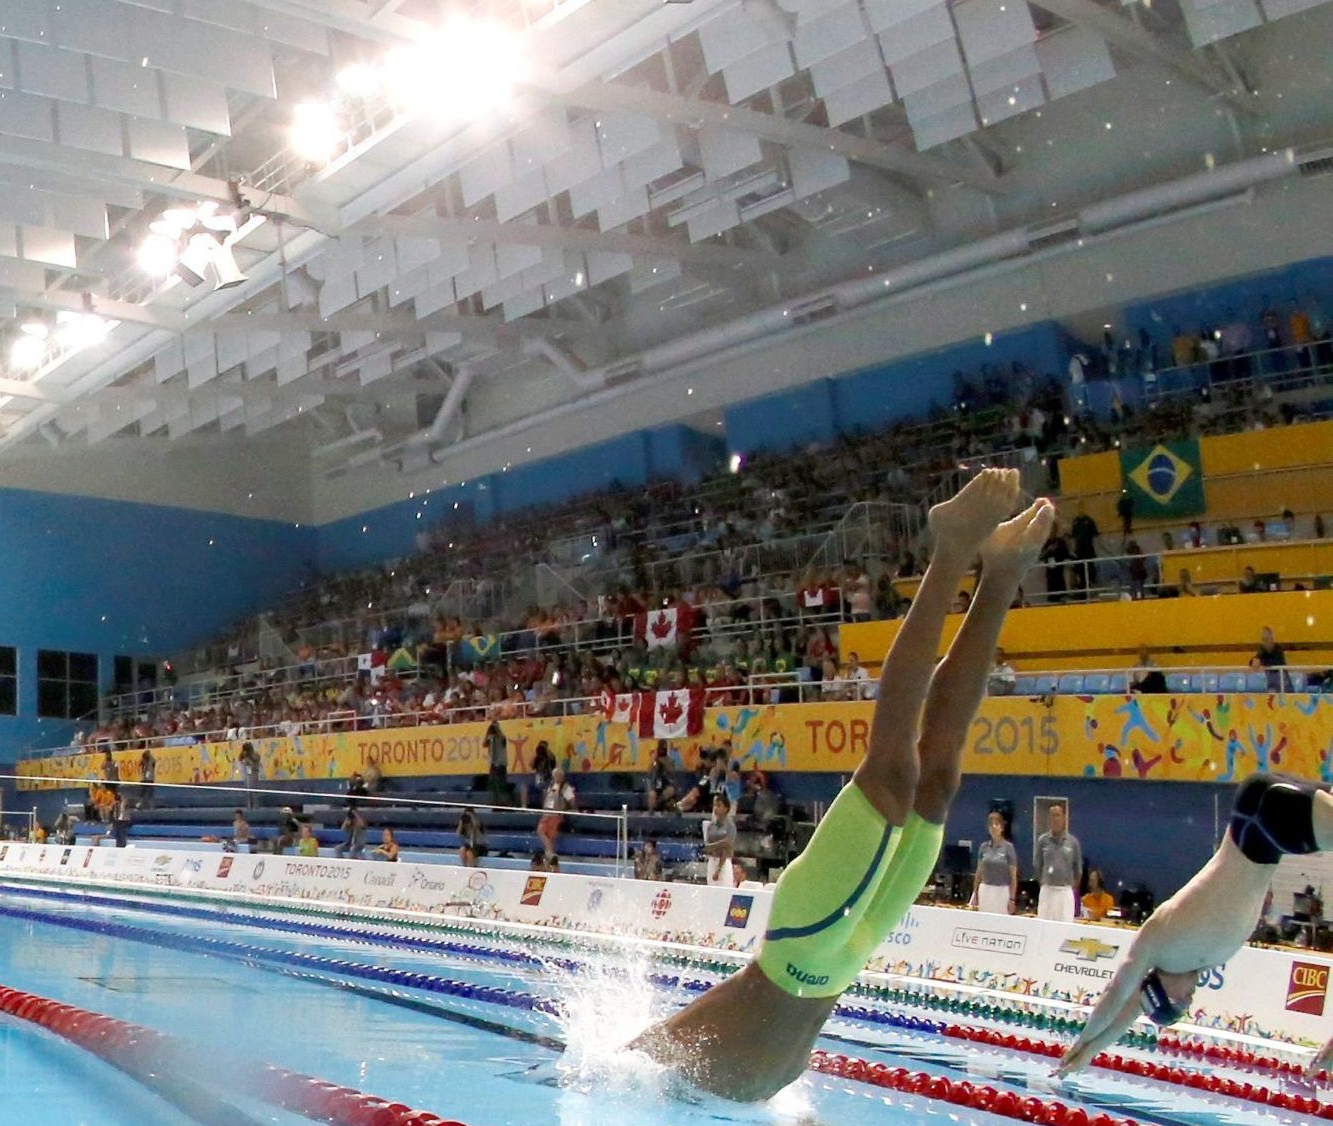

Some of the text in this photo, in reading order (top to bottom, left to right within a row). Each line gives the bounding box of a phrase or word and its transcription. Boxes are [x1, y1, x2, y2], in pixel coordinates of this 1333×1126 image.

[973, 716, 1060, 755] 2015
[357, 738, 444, 765] TORONTO
[955, 933, 978, 944] LIVE
[786, 962, 829, 986] arena
[1054, 963, 1115, 979] CHEVROLET
[1293, 966, 1328, 989] CIBC
